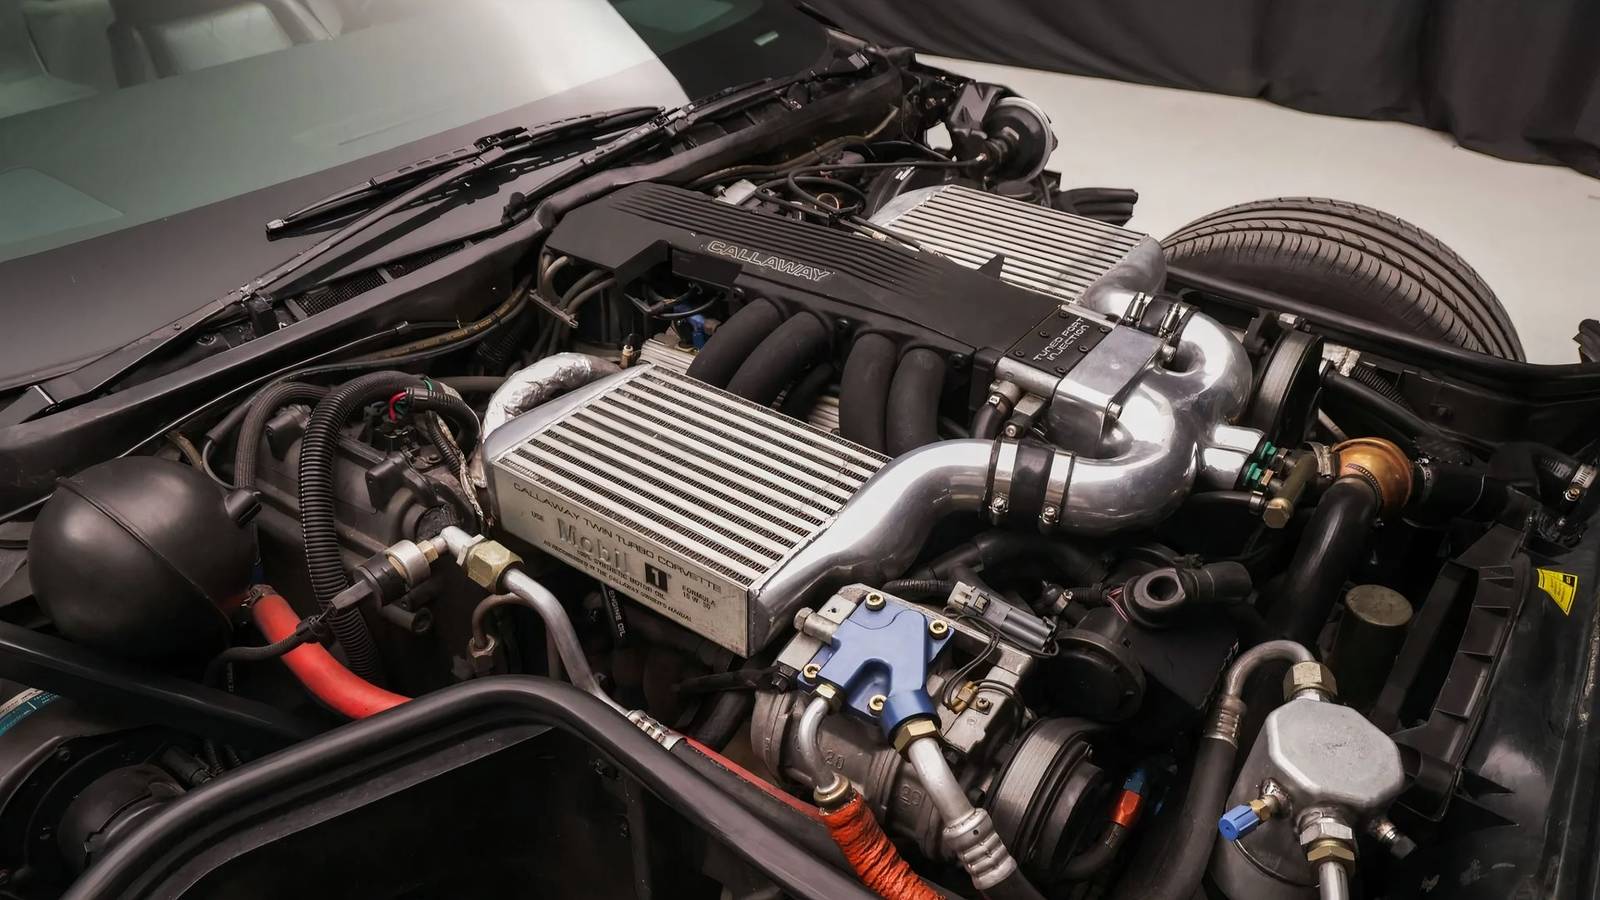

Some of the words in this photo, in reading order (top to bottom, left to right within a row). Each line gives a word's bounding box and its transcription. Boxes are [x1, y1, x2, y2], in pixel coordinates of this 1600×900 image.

[707, 240, 831, 282] CALLAWAY
[1033, 336, 1064, 361] TUNED
[1061, 316, 1085, 337] PORT
[1047, 324, 1090, 361] INJECTION
[530, 511, 545, 521] USE
[513, 481, 580, 520] CALLAWAY
[583, 517, 613, 538] TWIN
[615, 533, 655, 559] TURBO
[657, 555, 722, 593] CORVETTE
[556, 518, 630, 576] Mobil
[594, 559, 628, 581] SYNTHETIC
[629, 576, 653, 594] MOTOR
[654, 588, 667, 600] OIL
[608, 574, 640, 594] CALLAWAY
[681, 585, 717, 608] FORMULA
[608, 590, 622, 621] ENGINE
[617, 622, 626, 638] OIL
